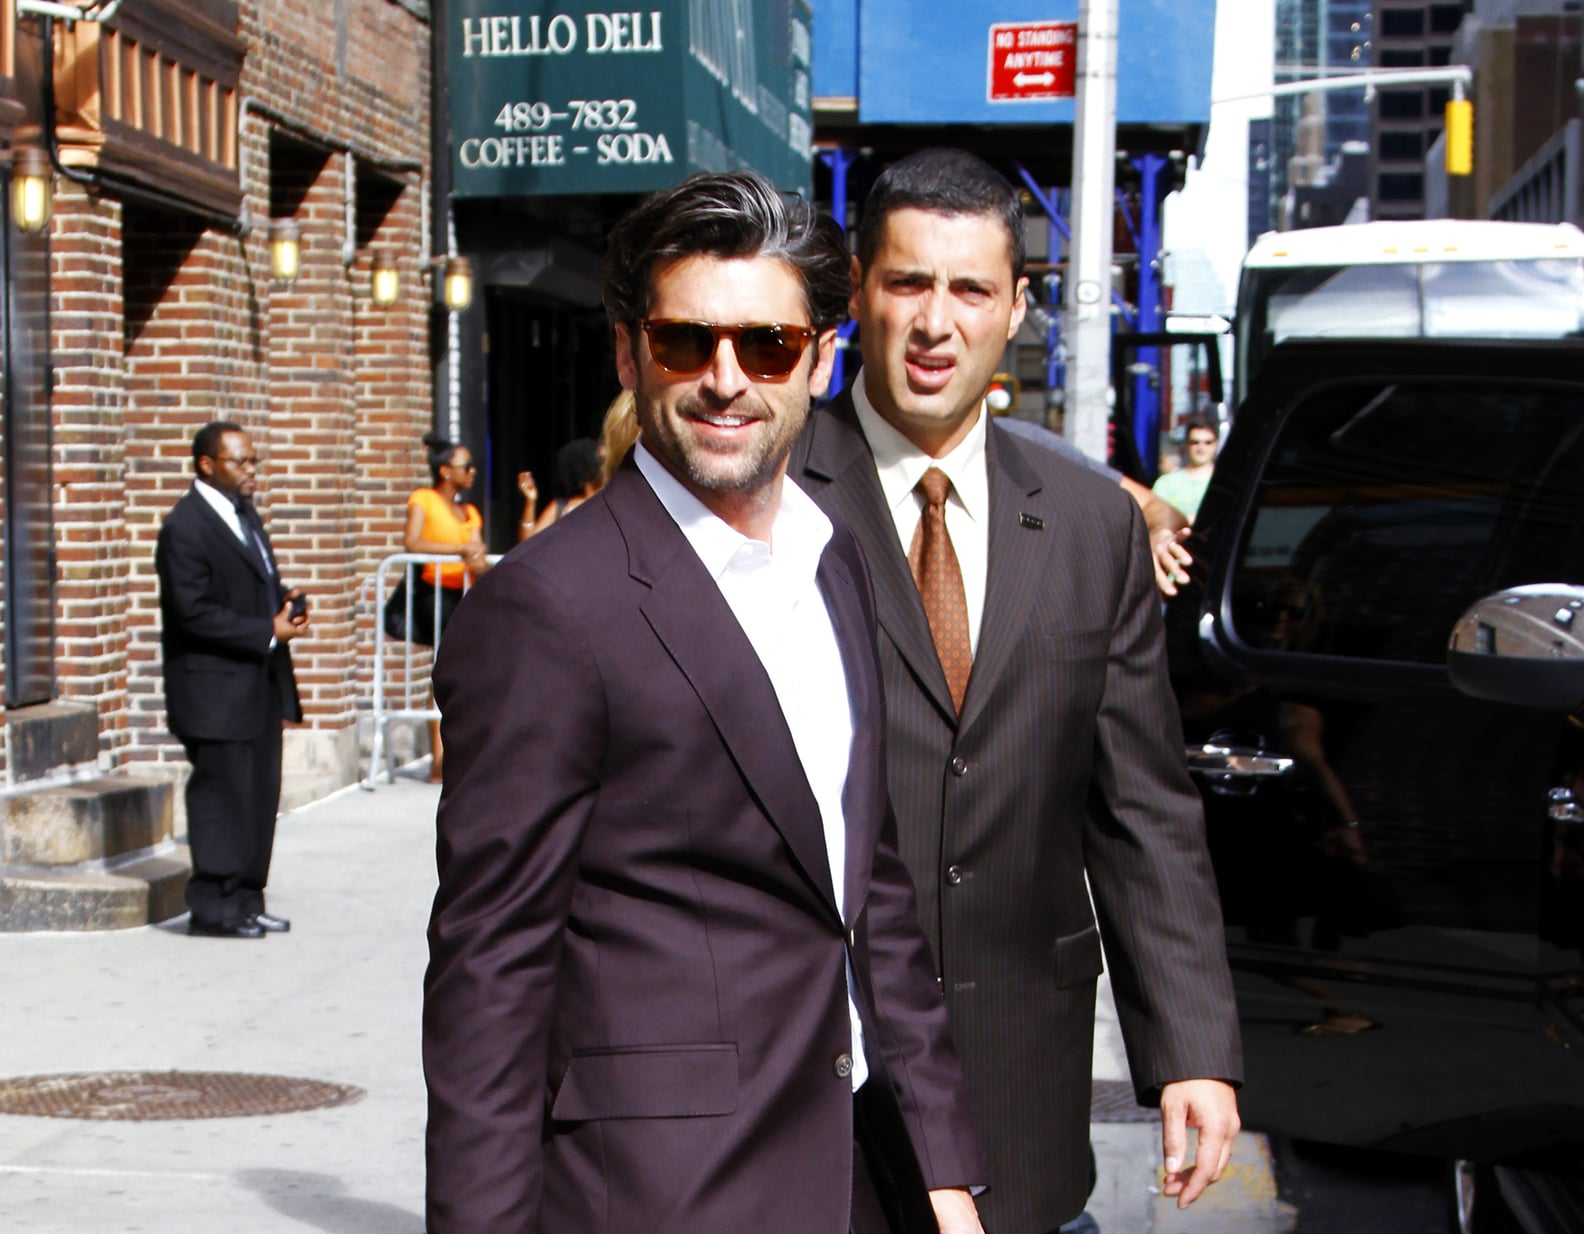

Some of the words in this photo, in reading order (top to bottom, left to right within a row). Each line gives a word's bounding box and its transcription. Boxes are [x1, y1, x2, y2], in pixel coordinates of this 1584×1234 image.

[463, 14, 577, 57] HELLO
[586, 11, 663, 54] DELI
[996, 31, 1014, 49] NO
[1017, 29, 1073, 48] STANDING
[1003, 50, 1064, 69] ANYTIME
[494, 99, 638, 132] 489-7832
[460, 135, 565, 168] COFFEE
[597, 133, 674, 165] SODA
